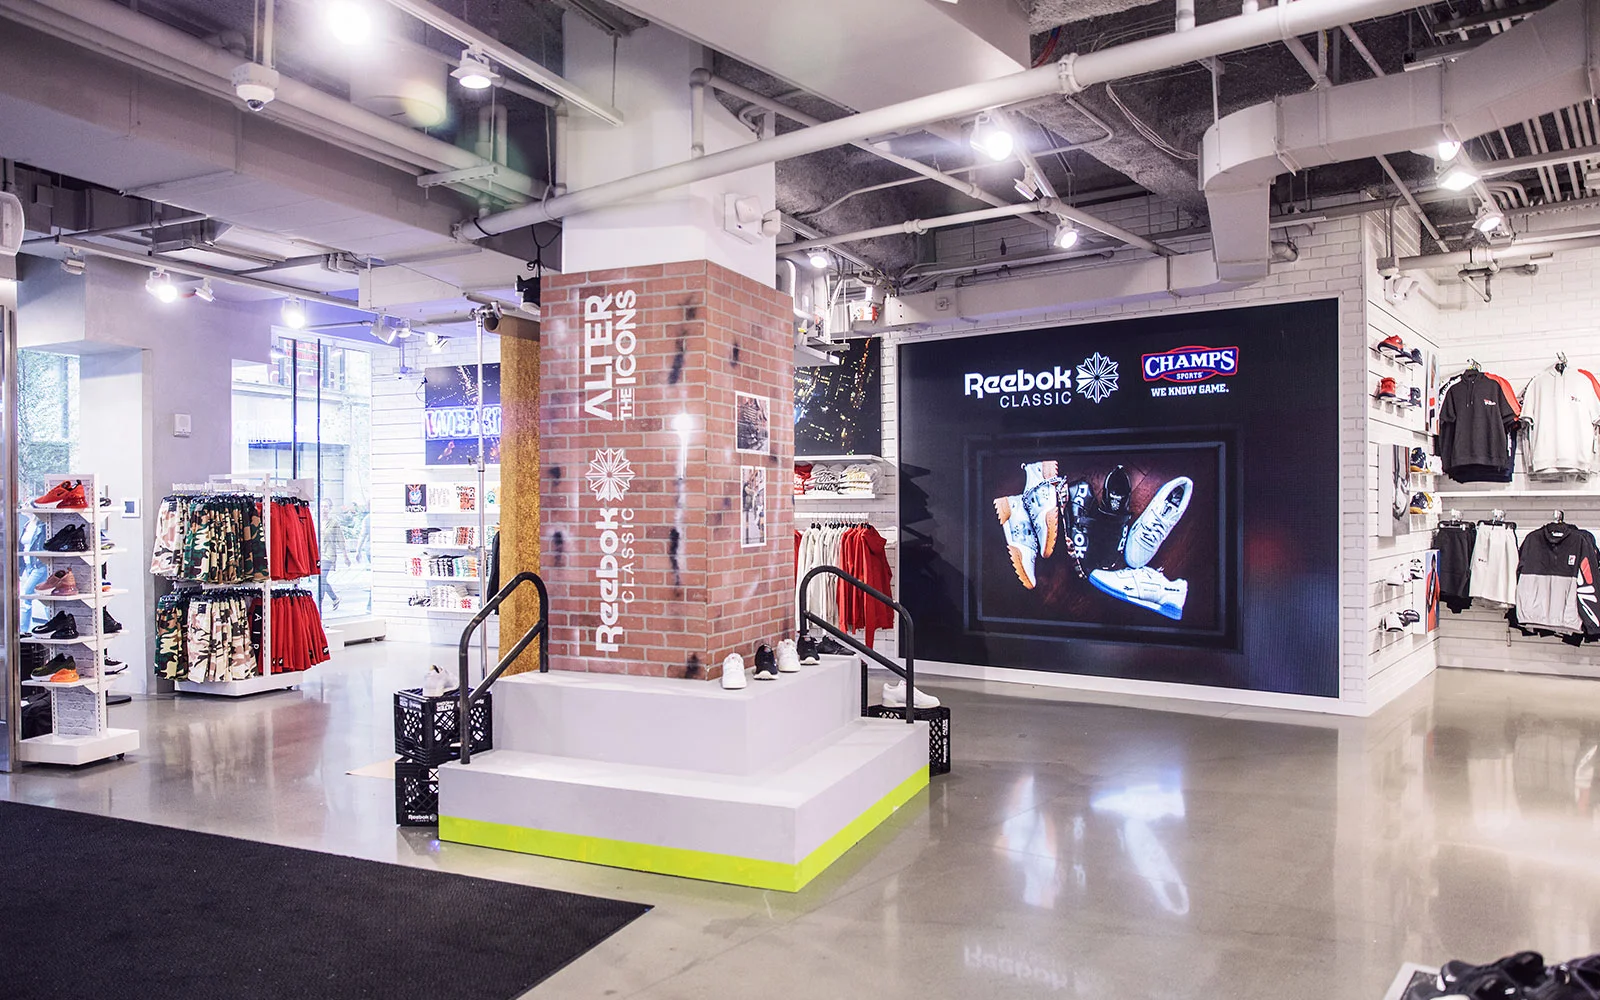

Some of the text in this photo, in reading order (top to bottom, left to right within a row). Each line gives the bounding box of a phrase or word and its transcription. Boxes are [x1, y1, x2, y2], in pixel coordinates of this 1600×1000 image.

[584, 292, 613, 421] ALTER
[615, 289, 637, 421] THE ICONS
[1145, 350, 1235, 377] CHAMPS
[964, 366, 1072, 399] Reebok
[1150, 383, 1230, 397] WE KNOW GAME.
[1176, 371, 1204, 380] SPORTS
[999, 391, 1072, 409] CLASSIC
[620, 507, 636, 604] CLASSIC
[595, 507, 624, 652] Reebok
